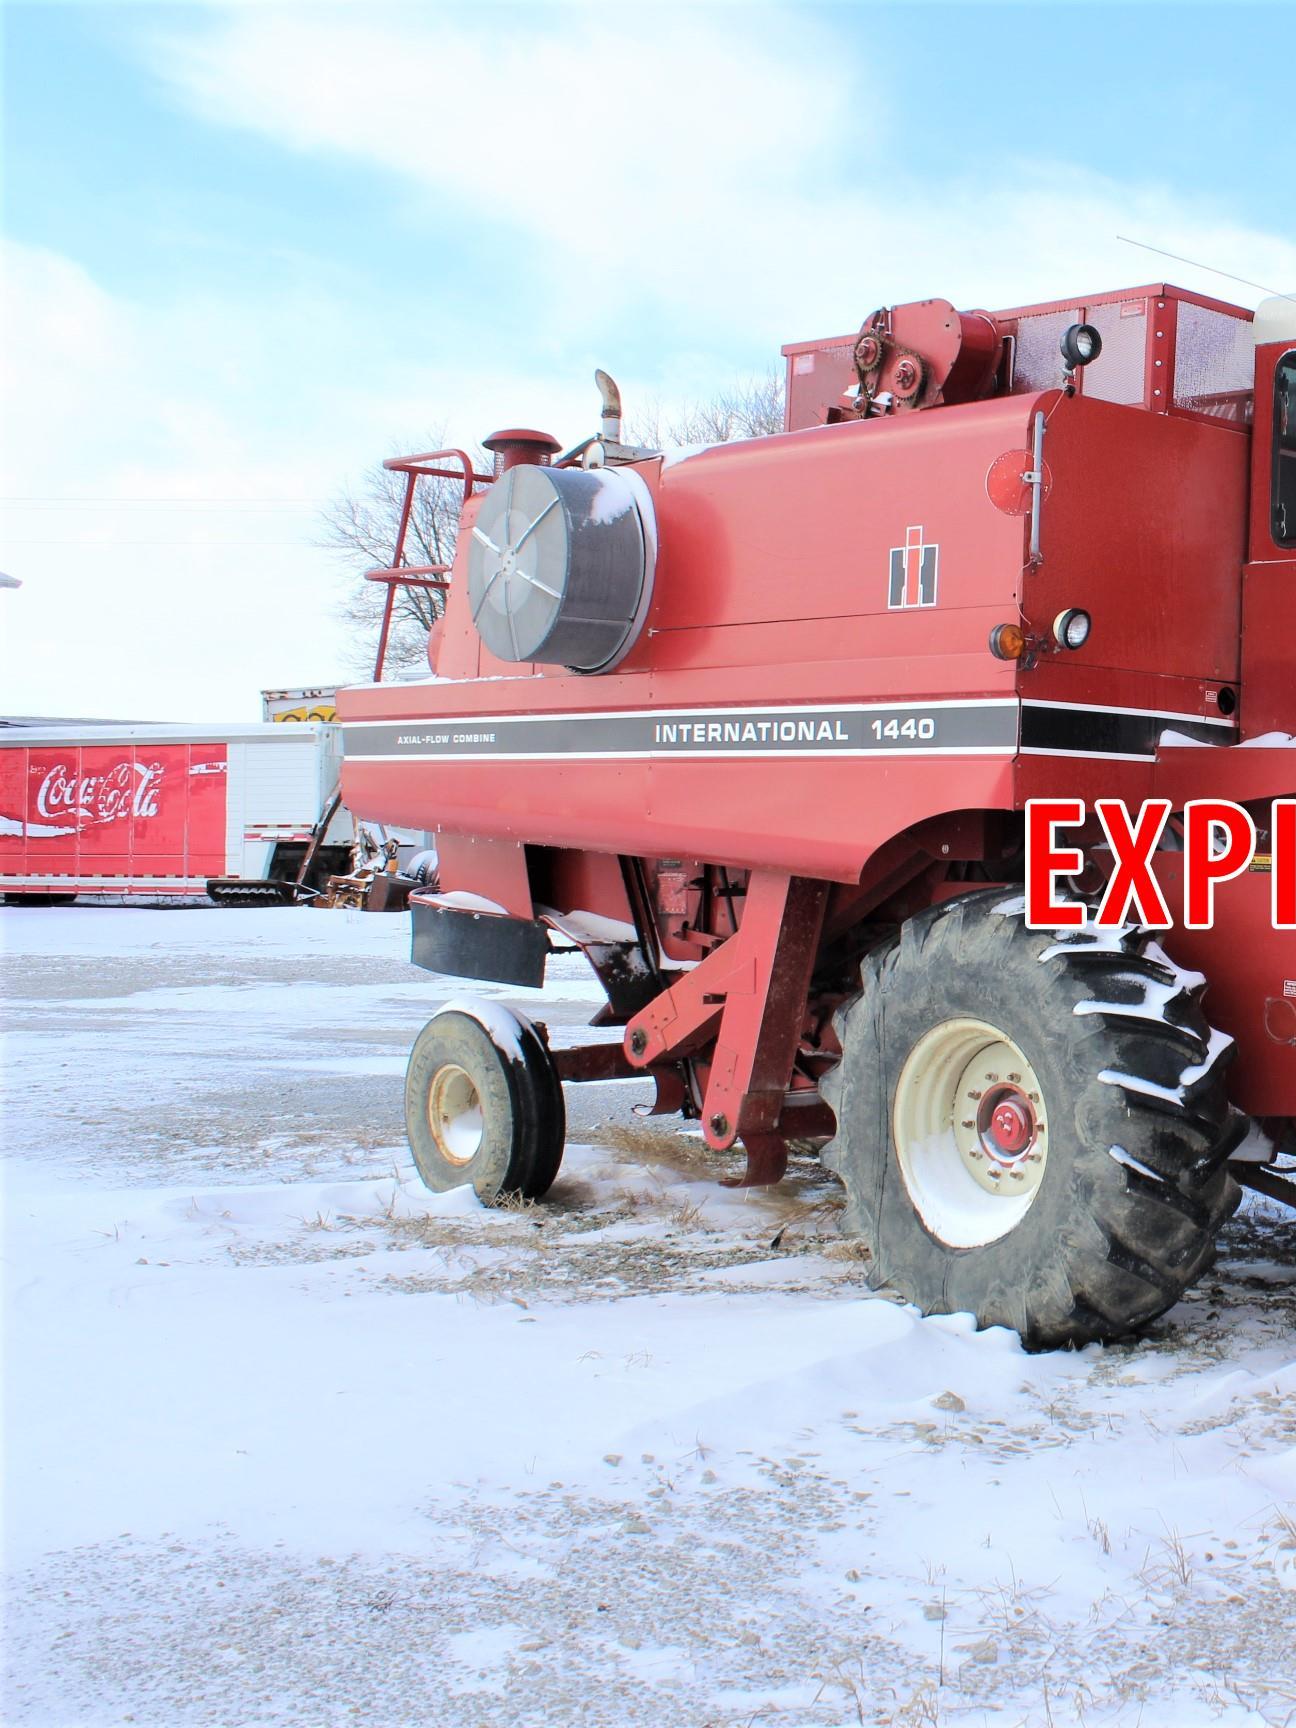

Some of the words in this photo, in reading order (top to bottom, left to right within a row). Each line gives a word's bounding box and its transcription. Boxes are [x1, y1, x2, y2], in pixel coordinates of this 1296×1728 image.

[397, 735, 450, 745] AXIAL-FLOW
[453, 733, 496, 744] COMBINE
[655, 720, 849, 743] INTERNATIONAL
[871, 718, 935, 740] 1440
